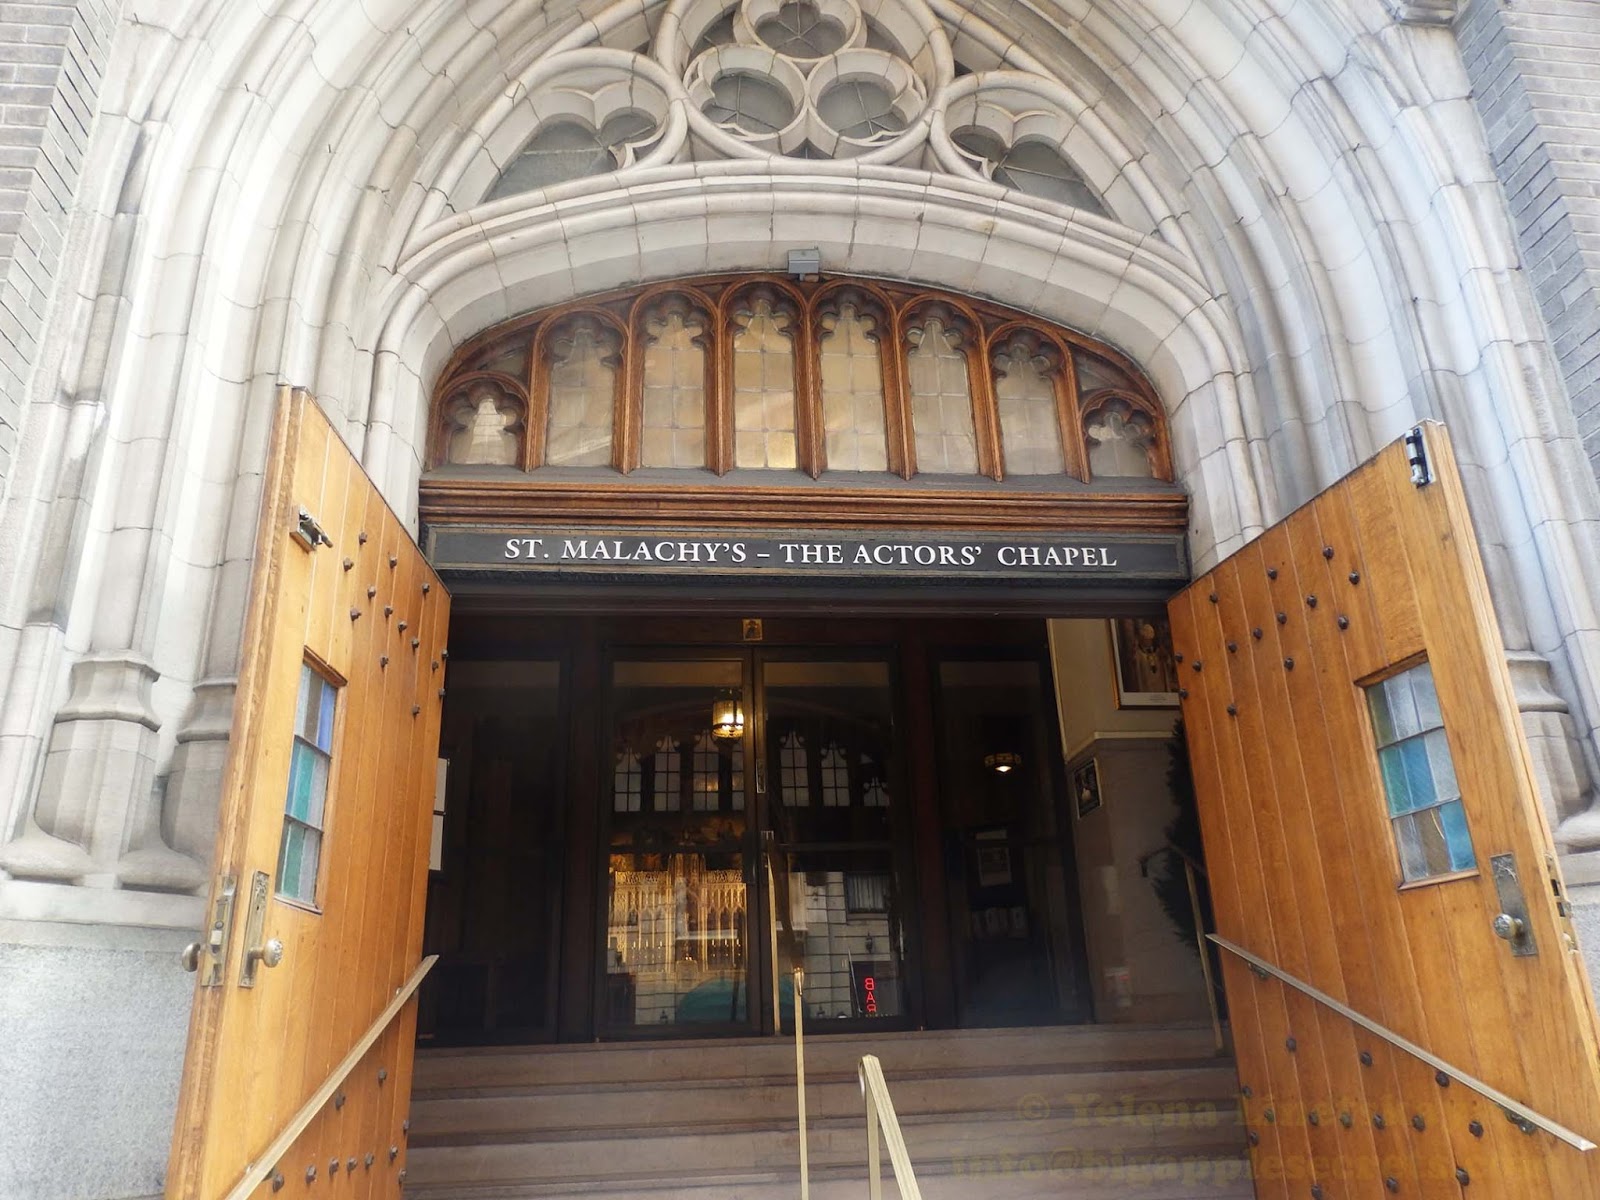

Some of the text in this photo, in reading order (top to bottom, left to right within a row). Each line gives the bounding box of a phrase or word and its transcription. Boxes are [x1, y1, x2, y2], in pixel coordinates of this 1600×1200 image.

[504, 538, 549, 559] ST.
[561, 539, 747, 562] MALACHY'S
[779, 543, 844, 564] THE
[852, 544, 982, 566] ACTORS'
[997, 546, 1118, 567] CHAPEL
